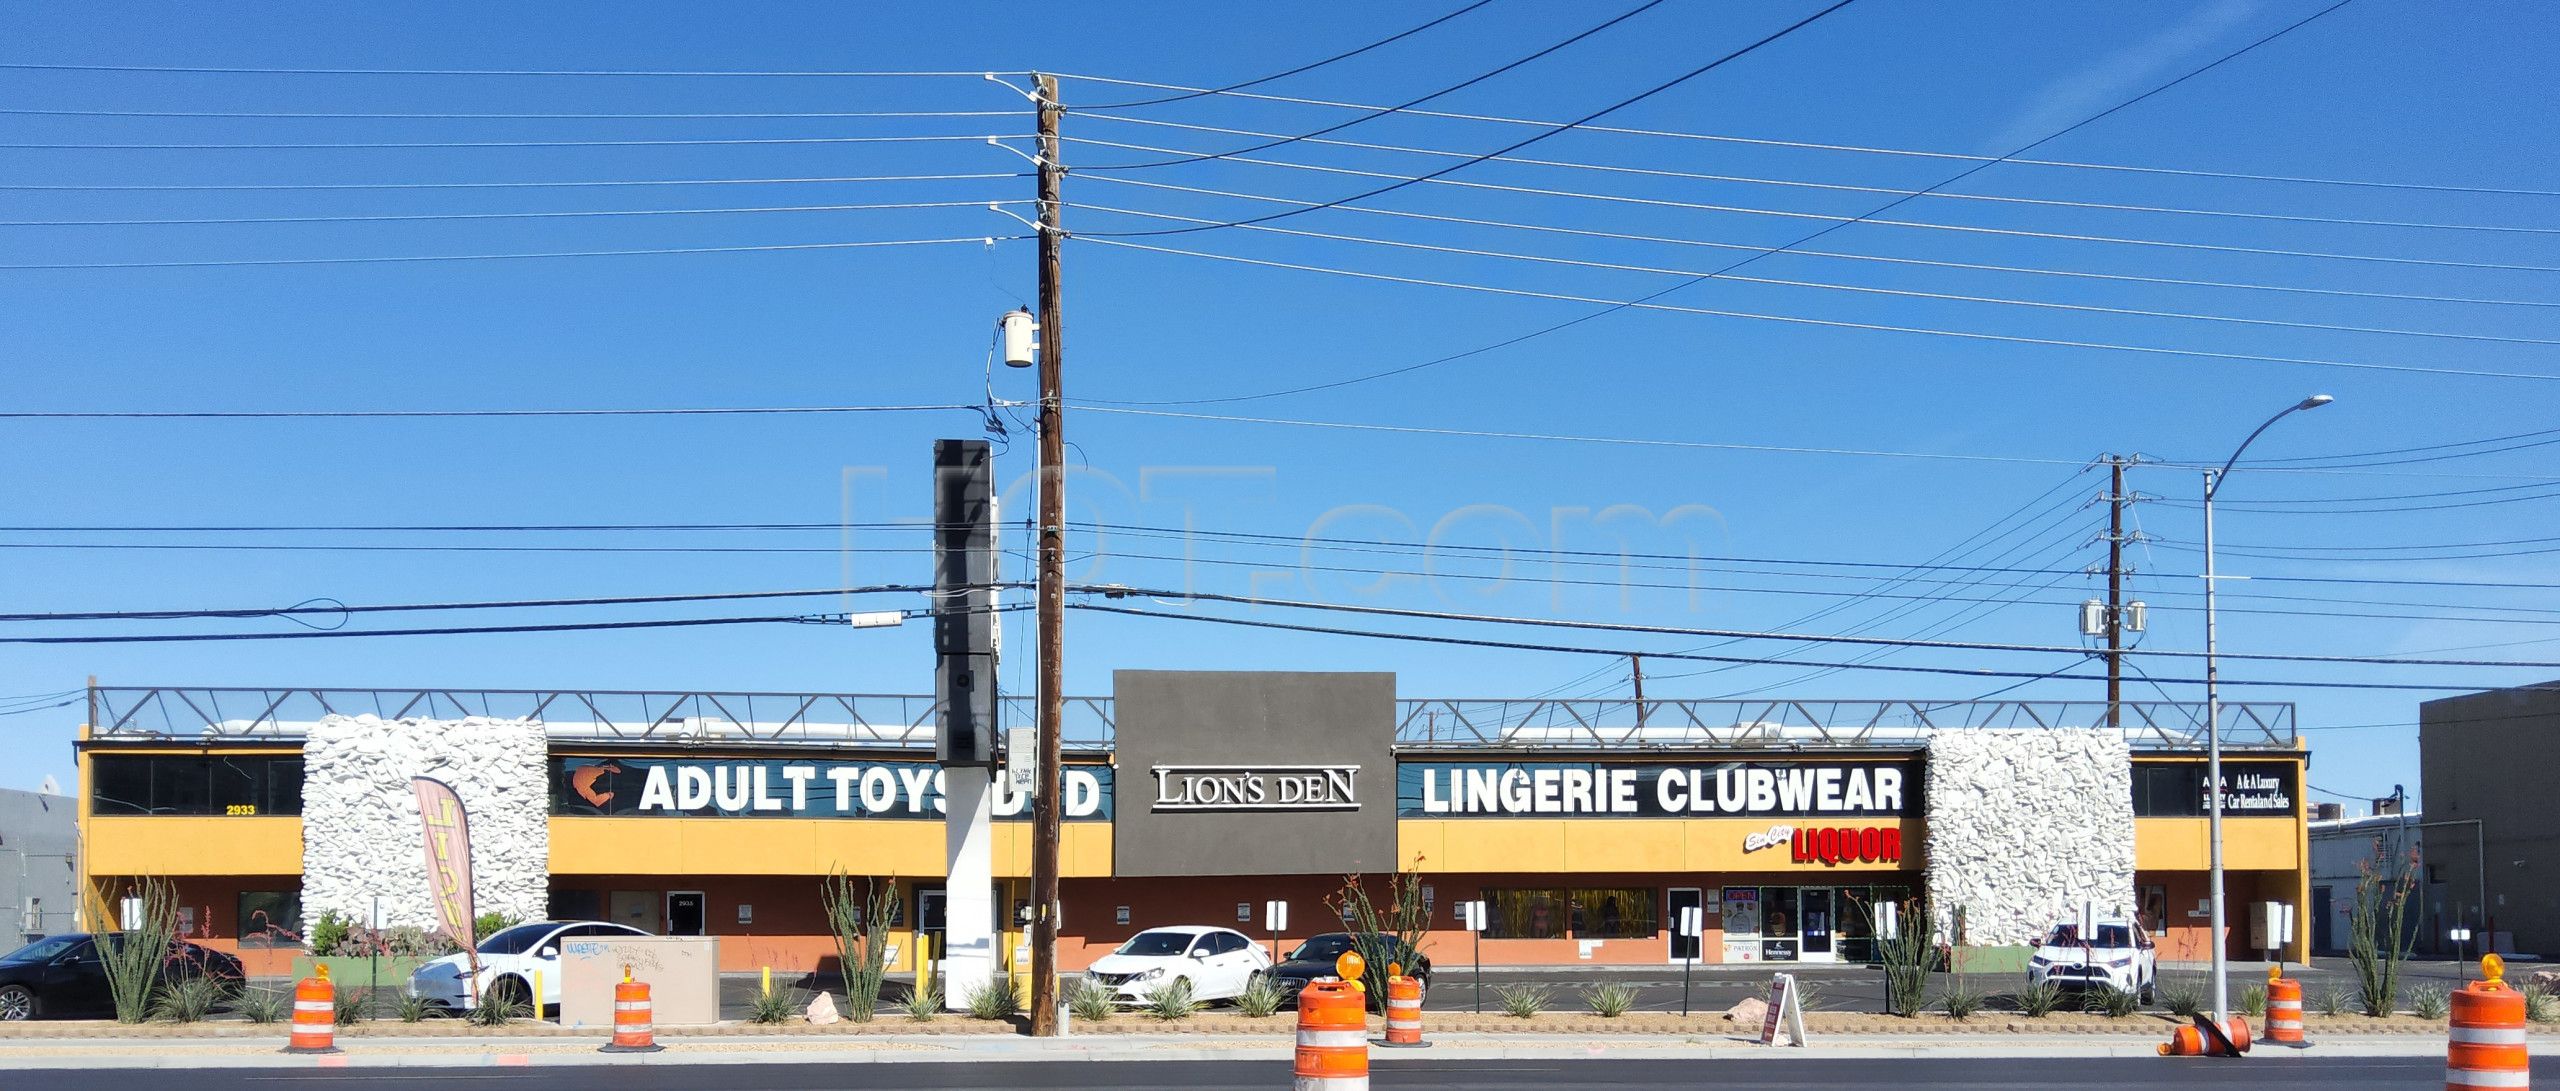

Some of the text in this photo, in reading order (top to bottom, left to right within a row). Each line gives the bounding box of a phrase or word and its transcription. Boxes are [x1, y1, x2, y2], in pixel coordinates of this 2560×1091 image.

[638, 765, 815, 811] ADULT
[991, 770, 1100, 816] DD
[1155, 769, 1357, 804] LION'S DEN
[1423, 767, 1903, 812] LINGERIE CLUBWEAR
[2236, 773, 2280, 794] A & A Luxury
[226, 804, 256, 816] 2933
[2228, 793, 2240, 809] Car
[2273, 792, 2289, 809] Sales
[1748, 827, 1791, 848] Sin City
[1792, 826, 1902, 864] LIQUOR
